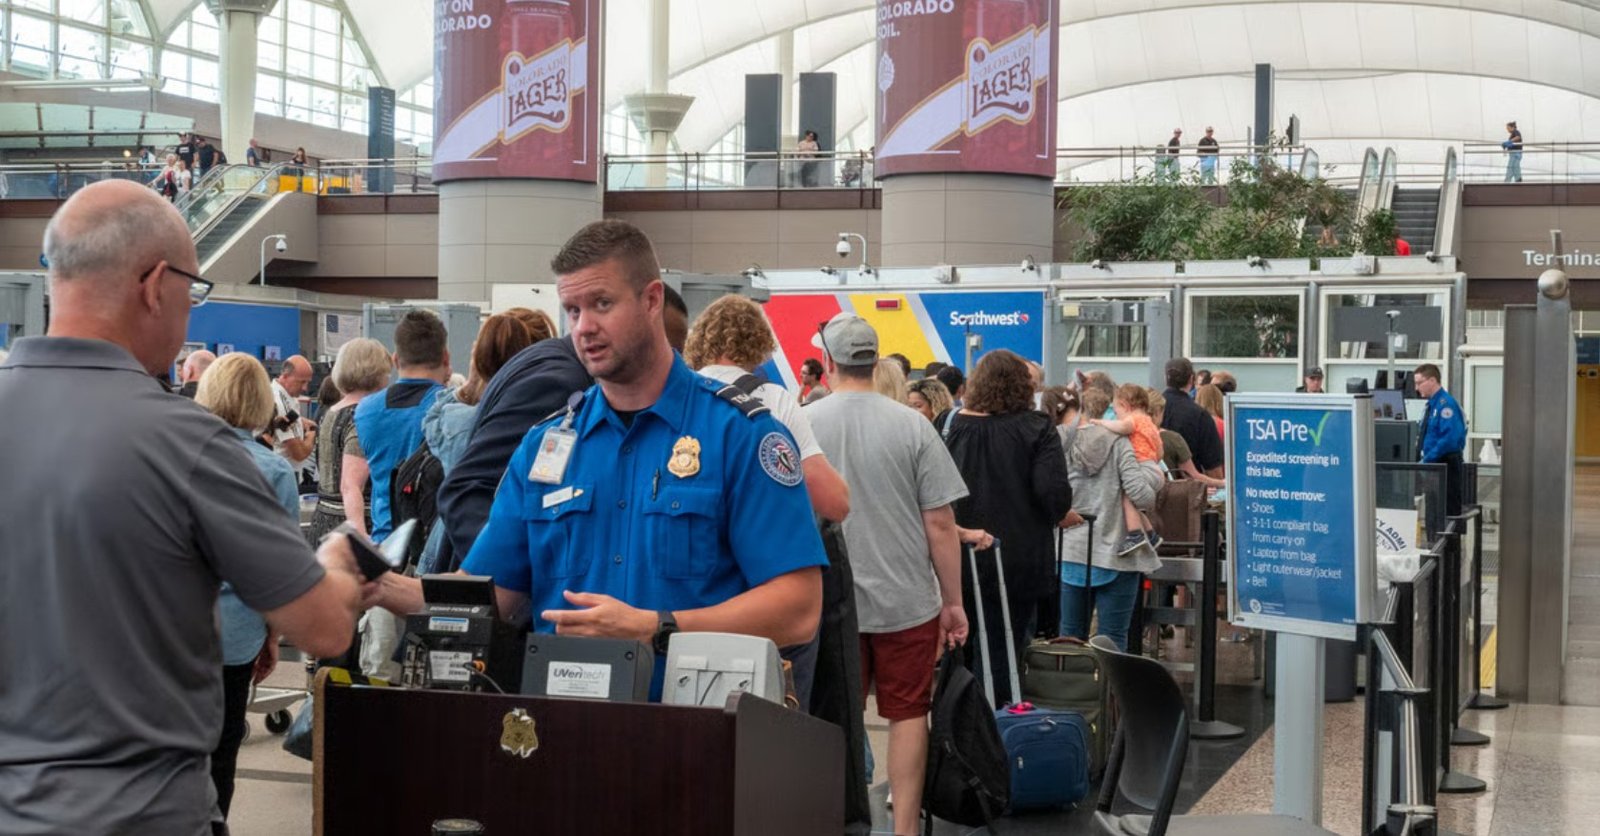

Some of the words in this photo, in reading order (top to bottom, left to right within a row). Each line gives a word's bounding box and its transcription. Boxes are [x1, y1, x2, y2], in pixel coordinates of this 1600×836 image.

[451, 0, 474, 13] ON
[436, 14, 492, 33] LORADO
[972, 56, 1031, 118] LAGER
[508, 68, 567, 127] LAGER
[950, 310, 1020, 326] Southwest
[1128, 303, 1140, 322] 1
[1246, 419, 1277, 441] TSA
[1281, 419, 1308, 441] Pre
[1246, 452, 1287, 464] Expedited
[1288, 454, 1329, 467] screening
[1330, 454, 1339, 465] in
[1246, 466, 1261, 476] this
[1262, 467, 1282, 478] lane.
[1246, 487, 1258, 498] No
[1258, 488, 1279, 499] need
[1280, 489, 1290, 500] to
[1291, 491, 1326, 502] remove:
[1252, 503, 1274, 514] Shoes
[1252, 517, 1270, 528] 3-1-1
[1272, 519, 1311, 532] compliant
[1313, 521, 1329, 534] bag
[1252, 532, 1271, 543] from
[1272, 534, 1305, 546] carry-on
[1252, 548, 1279, 560] Laptop
[1280, 549, 1299, 561] from
[1300, 551, 1317, 563] bag
[1252, 562, 1271, 574] Light
[1272, 564, 1342, 579] outerwear/jacket
[1252, 576, 1267, 587] Belt
